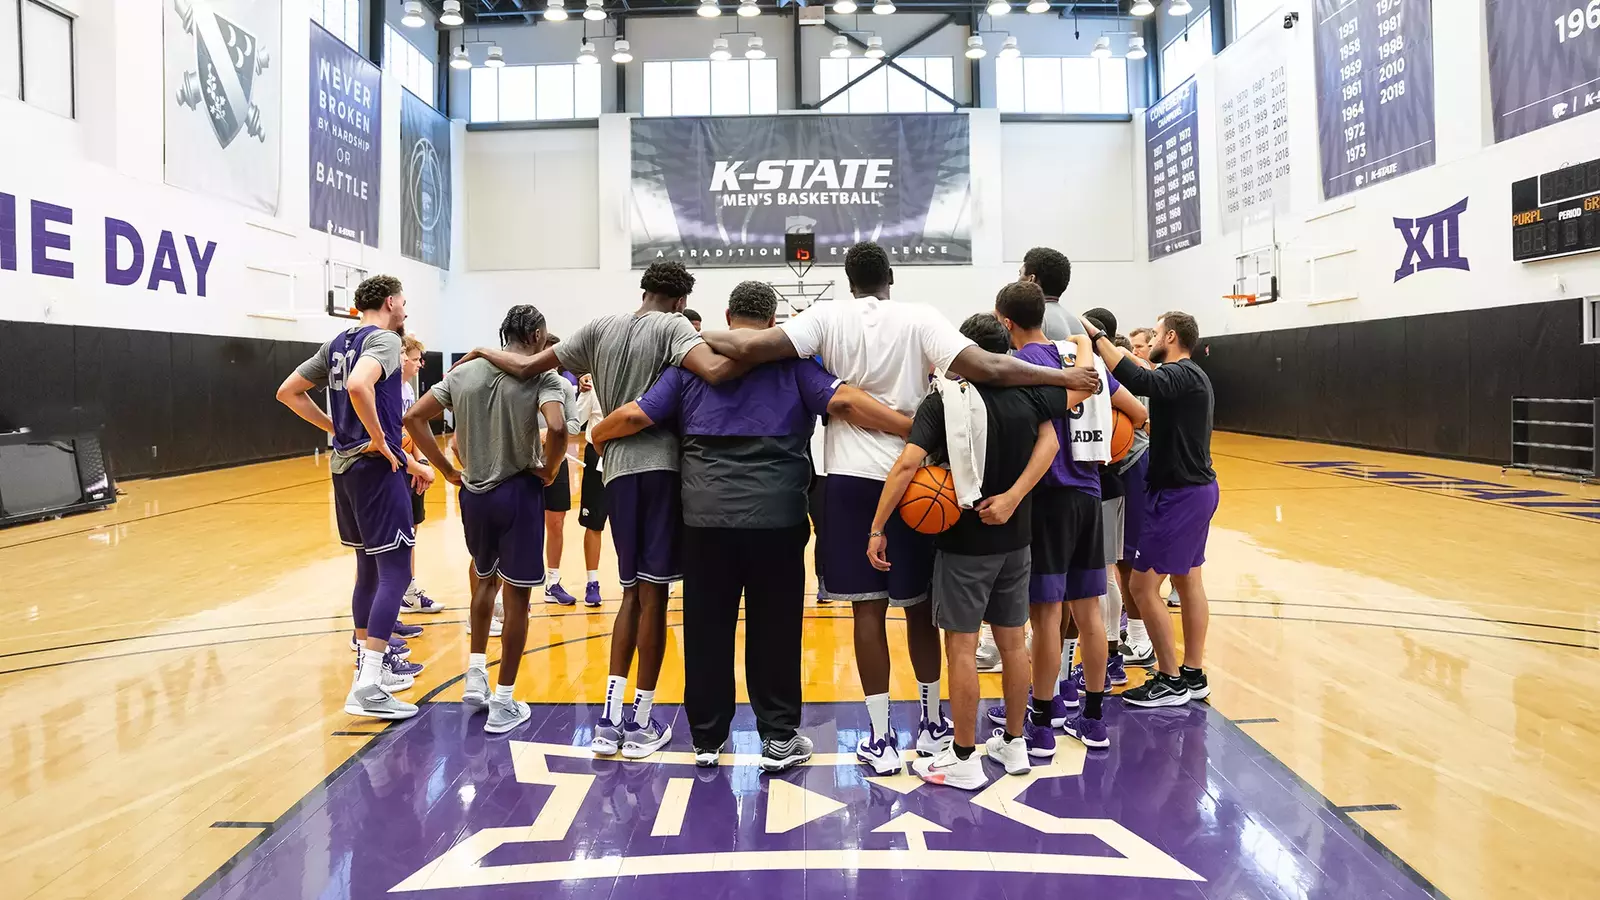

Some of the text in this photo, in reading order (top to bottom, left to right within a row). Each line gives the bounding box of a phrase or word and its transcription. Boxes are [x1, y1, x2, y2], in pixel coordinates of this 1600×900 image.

[1339, 12, 1401, 40] 1951 1981
[1555, 0, 1600, 43] 196
[1340, 35, 1403, 60] 1958 1988
[1270, 66, 1284, 82] 2011
[1340, 57, 1404, 83] 1959 2010
[320, 58, 370, 109] NEVER
[1272, 82, 1285, 98] 2012
[1342, 80, 1405, 104] 1961 2018
[320, 89, 370, 134] BROKEN
[1342, 100, 1364, 122] 1964
[318, 117, 370, 152] BY HARDSHIP
[1238, 119, 1250, 132] 1973
[1239, 134, 1251, 147] 1975
[1255, 125, 1268, 139] 1990
[1273, 115, 1287, 130] 2014
[1344, 122, 1365, 142] 1972
[337, 148, 350, 166] OR
[1240, 149, 1251, 162] 1977
[1256, 140, 1269, 155] 1993
[1274, 131, 1288, 146] 2017
[1346, 143, 1366, 163] 1973
[1181, 156, 1193, 170] 1977
[1240, 165, 1253, 177] 1980
[1257, 156, 1271, 170] 1996
[1275, 147, 1289, 162] 2018
[1371, 163, 1398, 181] K-STATE
[316, 161, 368, 200] BATTLE
[709, 159, 893, 191] K-STATE
[1182, 170, 1195, 185] 2013
[1242, 180, 1253, 192] 1981
[1257, 172, 1272, 186] 2008
[1276, 164, 1290, 178] 2019
[722, 192, 880, 206] MEN'S BASKETBALL
[1183, 186, 1196, 200] 2019
[1242, 195, 1254, 207] 1982
[1259, 188, 1272, 202] 2010
[1513, 209, 1543, 227] PURPL
[1559, 208, 1581, 220] PERIOD
[1170, 221, 1182, 233] 1970
[1393, 196, 1470, 284] XII
[105, 216, 217, 297] DAY
[678, 248, 780, 257] TRADITION
[830, 246, 948, 255] EXLENCE
[1071, 430, 1103, 443] ADE
